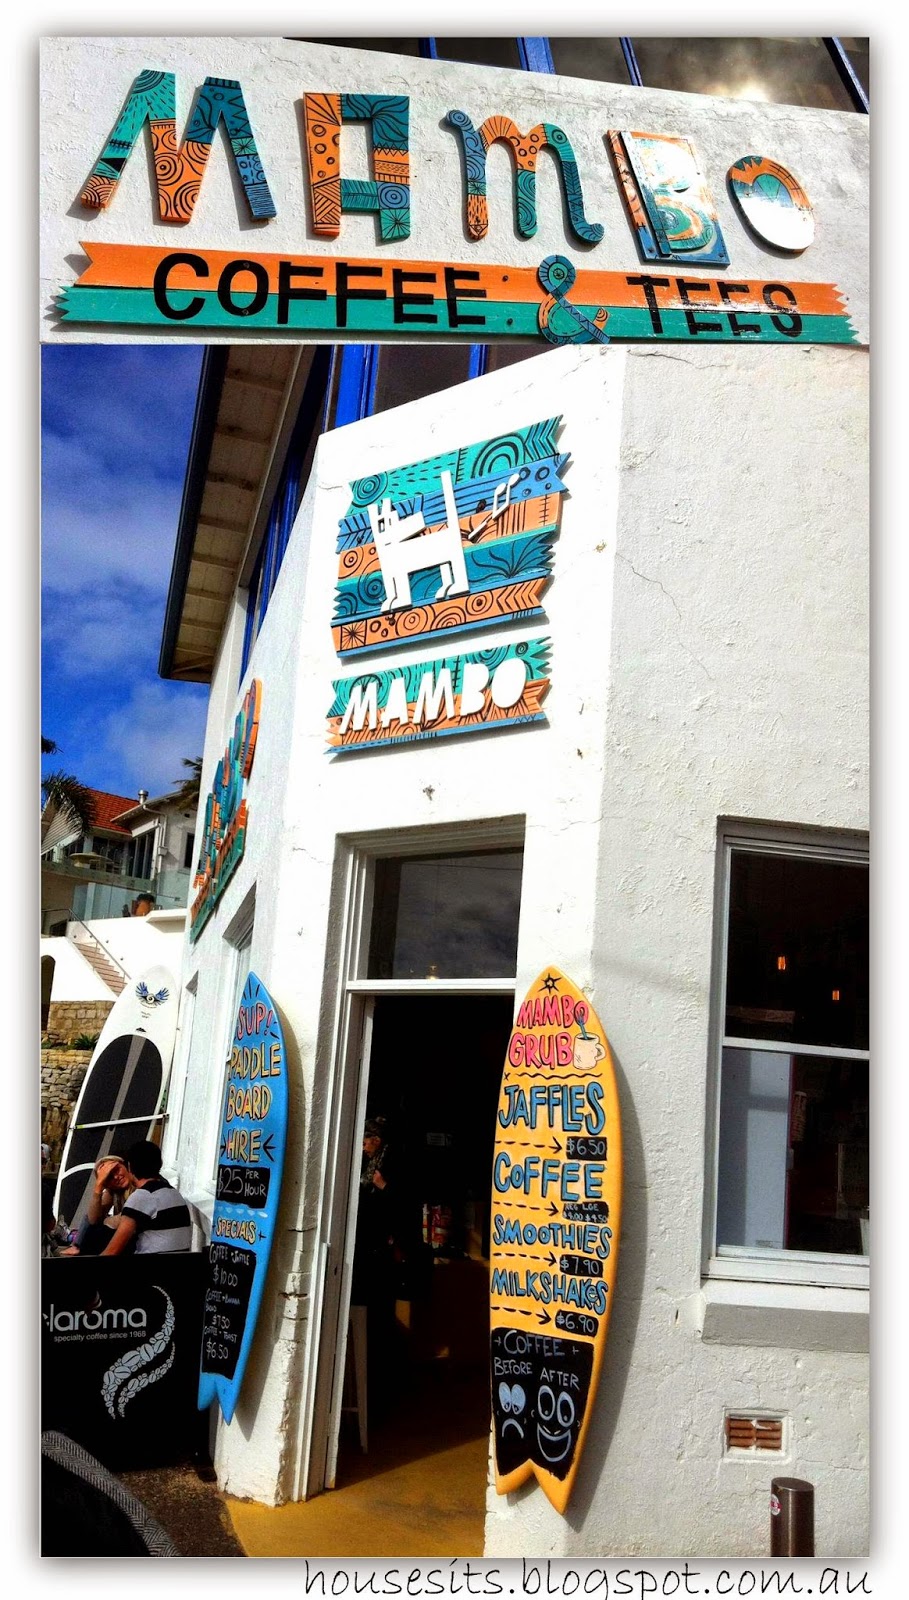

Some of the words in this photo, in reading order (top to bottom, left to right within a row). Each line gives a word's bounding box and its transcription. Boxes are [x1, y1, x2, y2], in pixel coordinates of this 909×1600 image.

[153, 252, 488, 328] COFFEE
[537, 254, 610, 344] &
[626, 274, 803, 338] TEES
[339, 657, 528, 735] MAMBO
[516, 994, 589, 1029] MAMBO
[228, 1042, 281, 1081] PADDLE
[508, 1031, 574, 1071] GRUB
[226, 1084, 271, 1123] BOARD
[498, 1081, 606, 1136] JAFFLES
[226, 1129, 262, 1163] HIRE
[217, 1167, 244, 1198] $25
[244, 1182, 267, 1198] HOUR
[245, 1168, 260, 1180] PER
[216, 1217, 256, 1245] SPECIALS
[492, 1213, 613, 1261] SMOOTHIES
[54, 1333, 84, 1342] specialty
[85, 1333, 109, 1341] coffee
[109, 1331, 128, 1340] since
[129, 1330, 147, 1338] 1968
[556, 1315, 595, 1334] $6.90
[503, 1330, 565, 1356] COFFEE
[494, 1357, 533, 1376] BEFORE
[540, 1367, 580, 1390] AFTER
